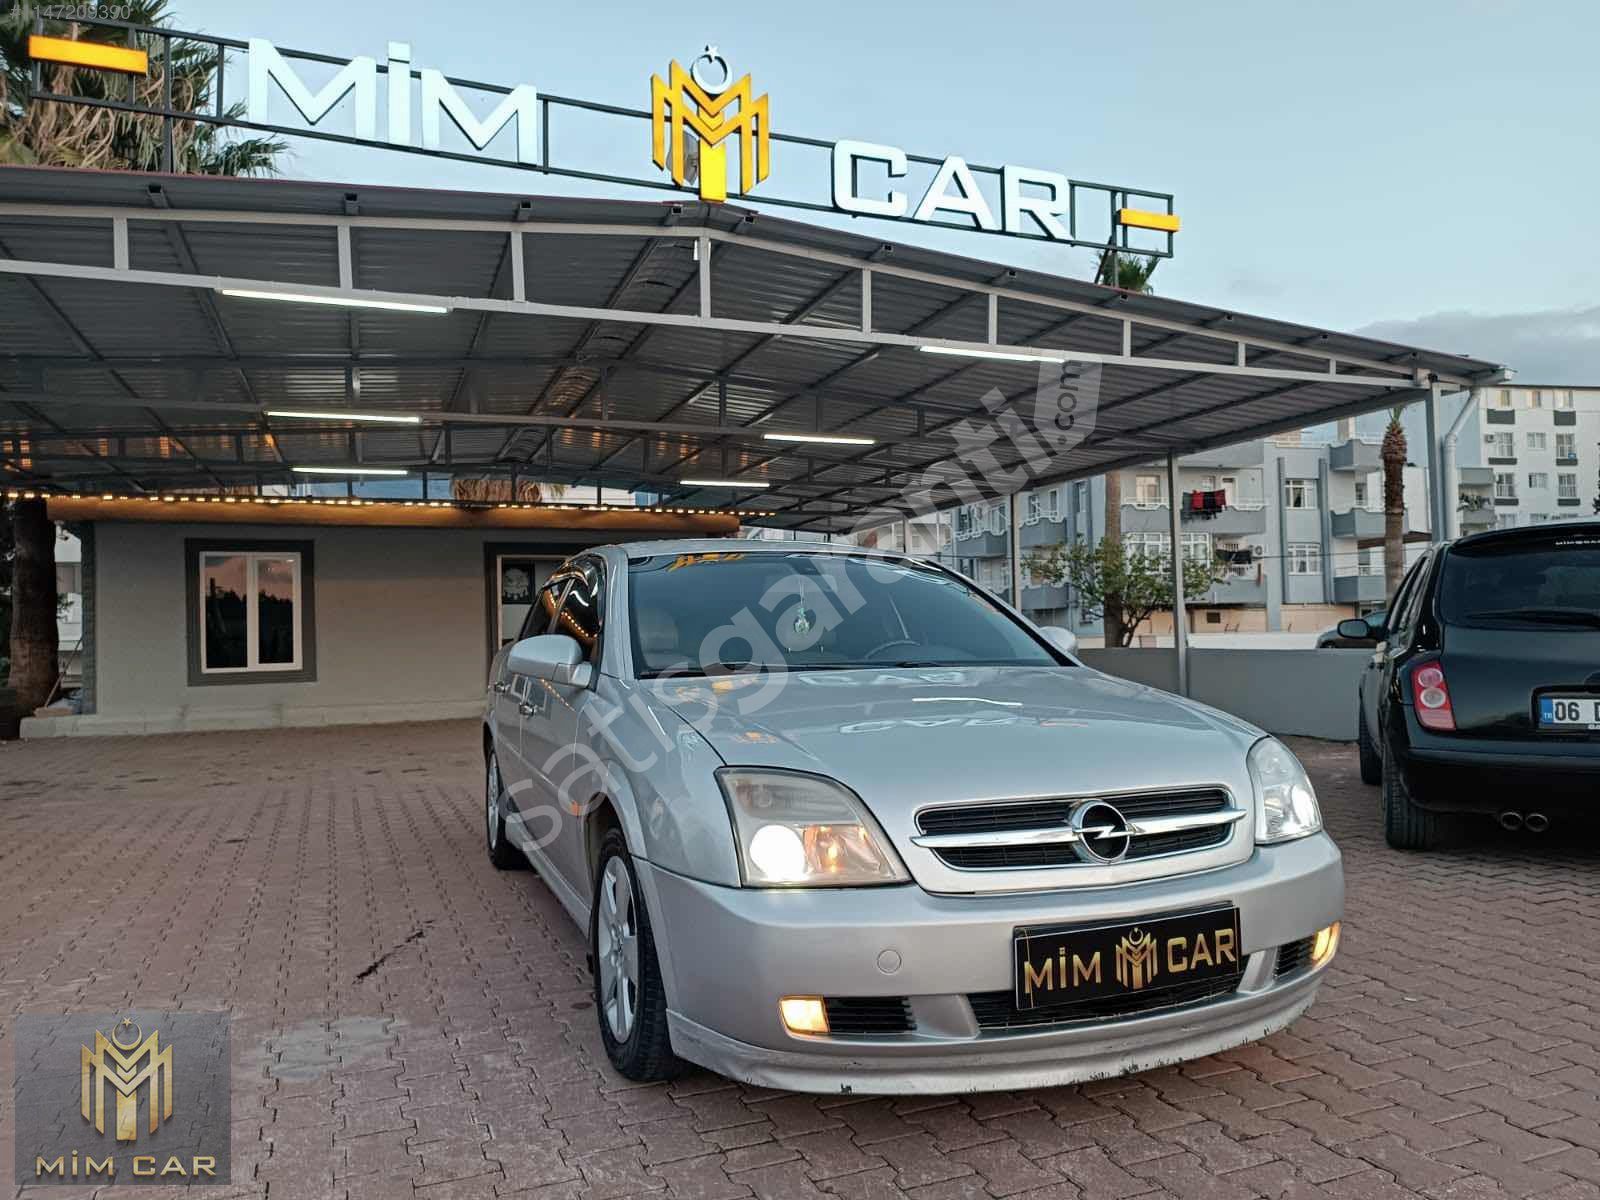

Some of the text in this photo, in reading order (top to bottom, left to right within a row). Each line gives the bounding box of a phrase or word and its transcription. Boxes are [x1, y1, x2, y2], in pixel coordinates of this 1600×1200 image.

[832, 139, 1076, 241] CAR
[1555, 702, 1580, 721] 06
[1167, 928, 1236, 973] CAR
